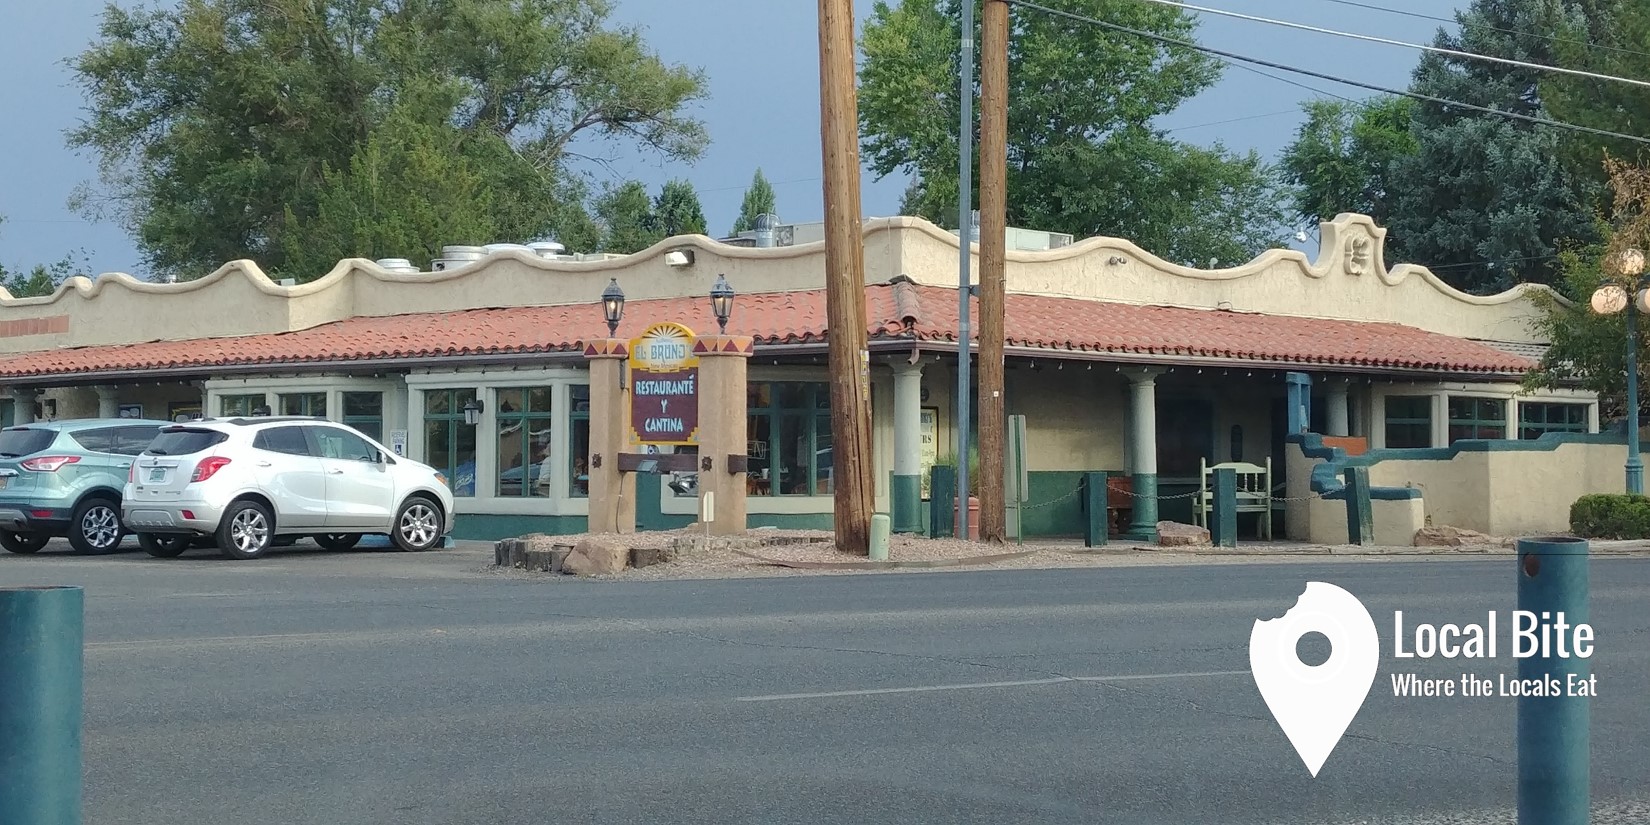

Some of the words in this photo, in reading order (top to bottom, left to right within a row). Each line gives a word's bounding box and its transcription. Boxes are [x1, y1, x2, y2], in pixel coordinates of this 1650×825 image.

[635, 345, 646, 359] EL
[635, 374, 694, 395] RESTAURANTÉ
[661, 399, 668, 413] Y
[645, 417, 683, 432] CANTINA
